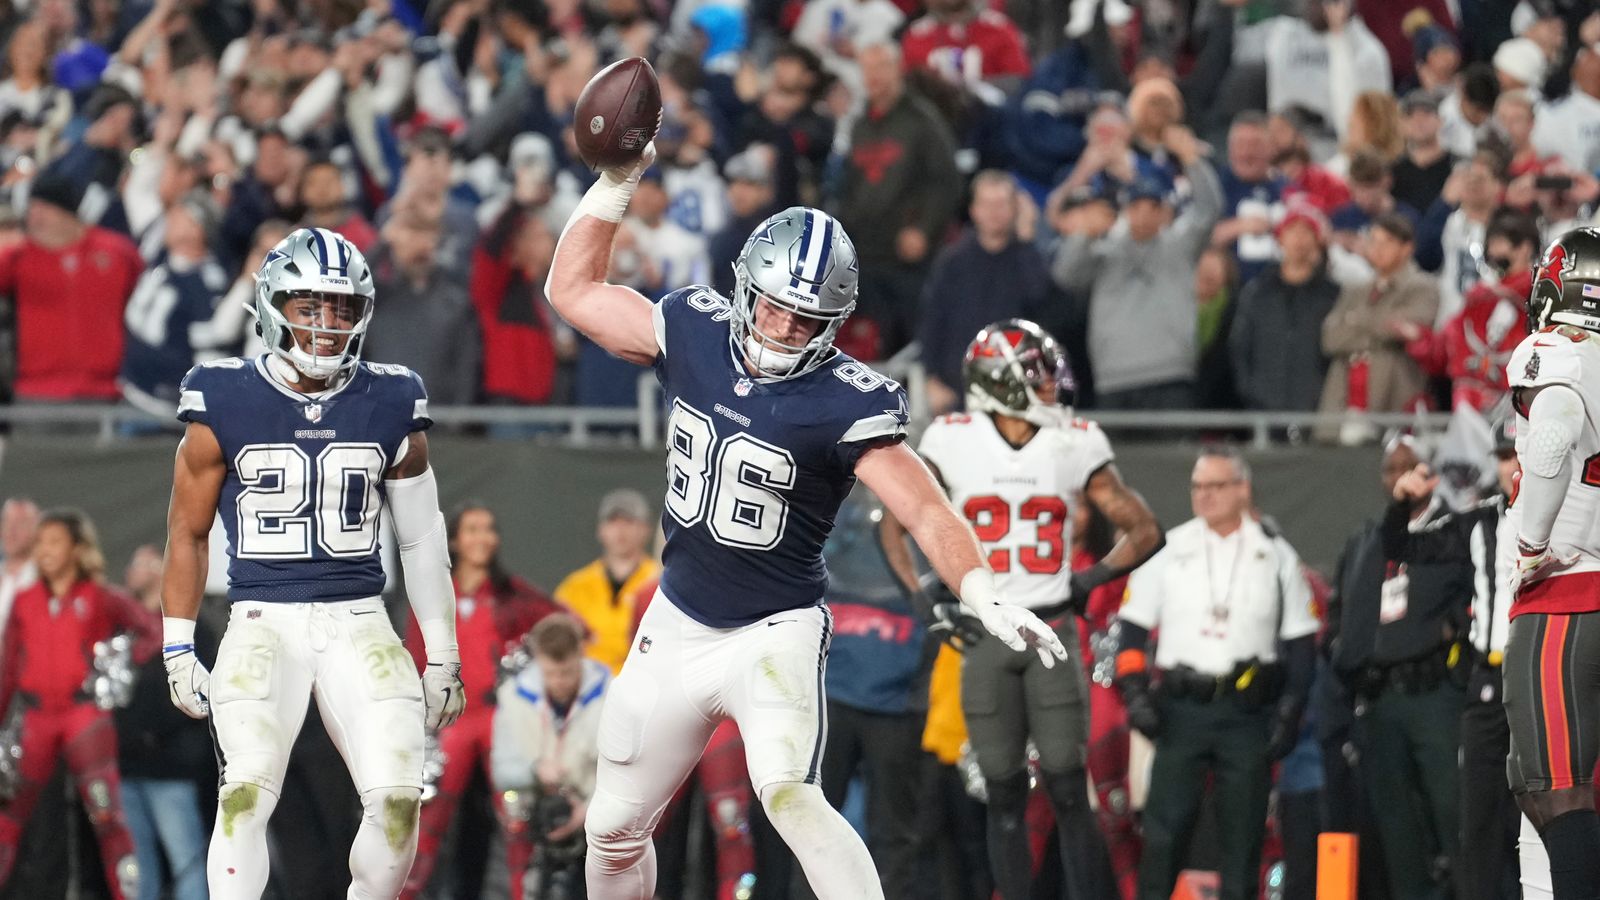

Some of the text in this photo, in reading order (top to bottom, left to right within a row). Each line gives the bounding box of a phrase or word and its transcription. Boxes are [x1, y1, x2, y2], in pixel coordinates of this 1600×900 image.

[787, 290, 814, 303] COWBOYS
[294, 429, 336, 439] COWBOYS
[713, 402, 752, 428] COWBOYS
[665, 396, 797, 551] 86
[234, 442, 387, 559] 20
[963, 495, 1067, 574] 23
